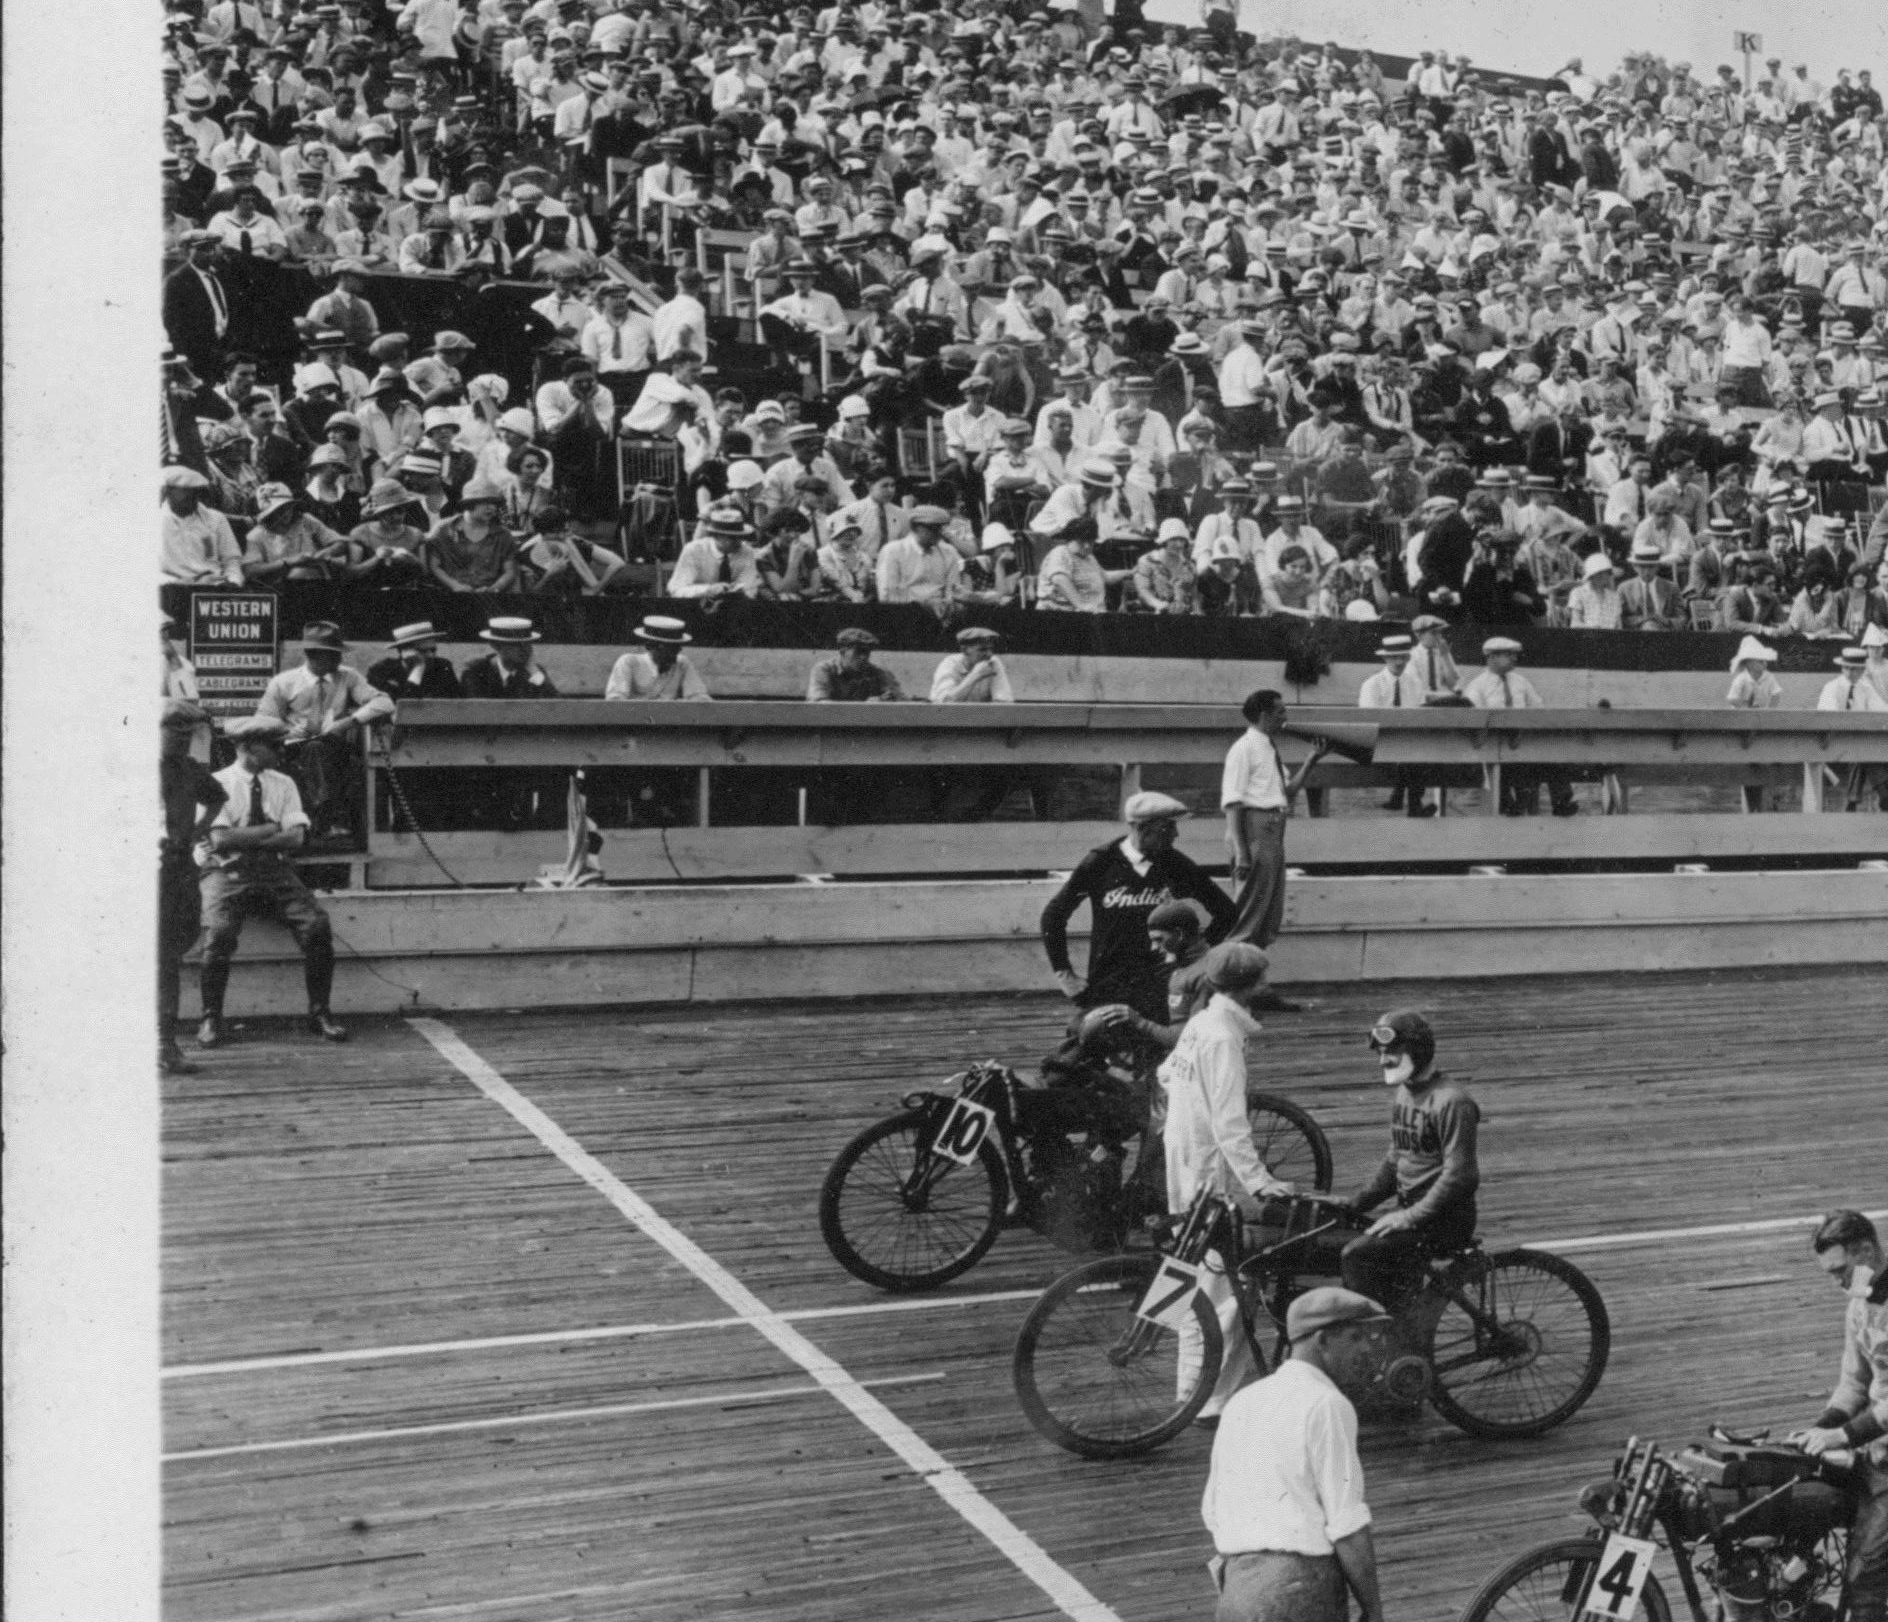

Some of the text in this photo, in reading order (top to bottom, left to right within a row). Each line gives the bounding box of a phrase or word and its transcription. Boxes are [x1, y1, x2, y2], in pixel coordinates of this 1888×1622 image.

[199, 600, 272, 617] WESTERN
[209, 623, 261, 639] UNION
[938, 1102, 987, 1157] 10
[1143, 1265, 1198, 1318] 7
[1599, 1549, 1638, 1615] 4
